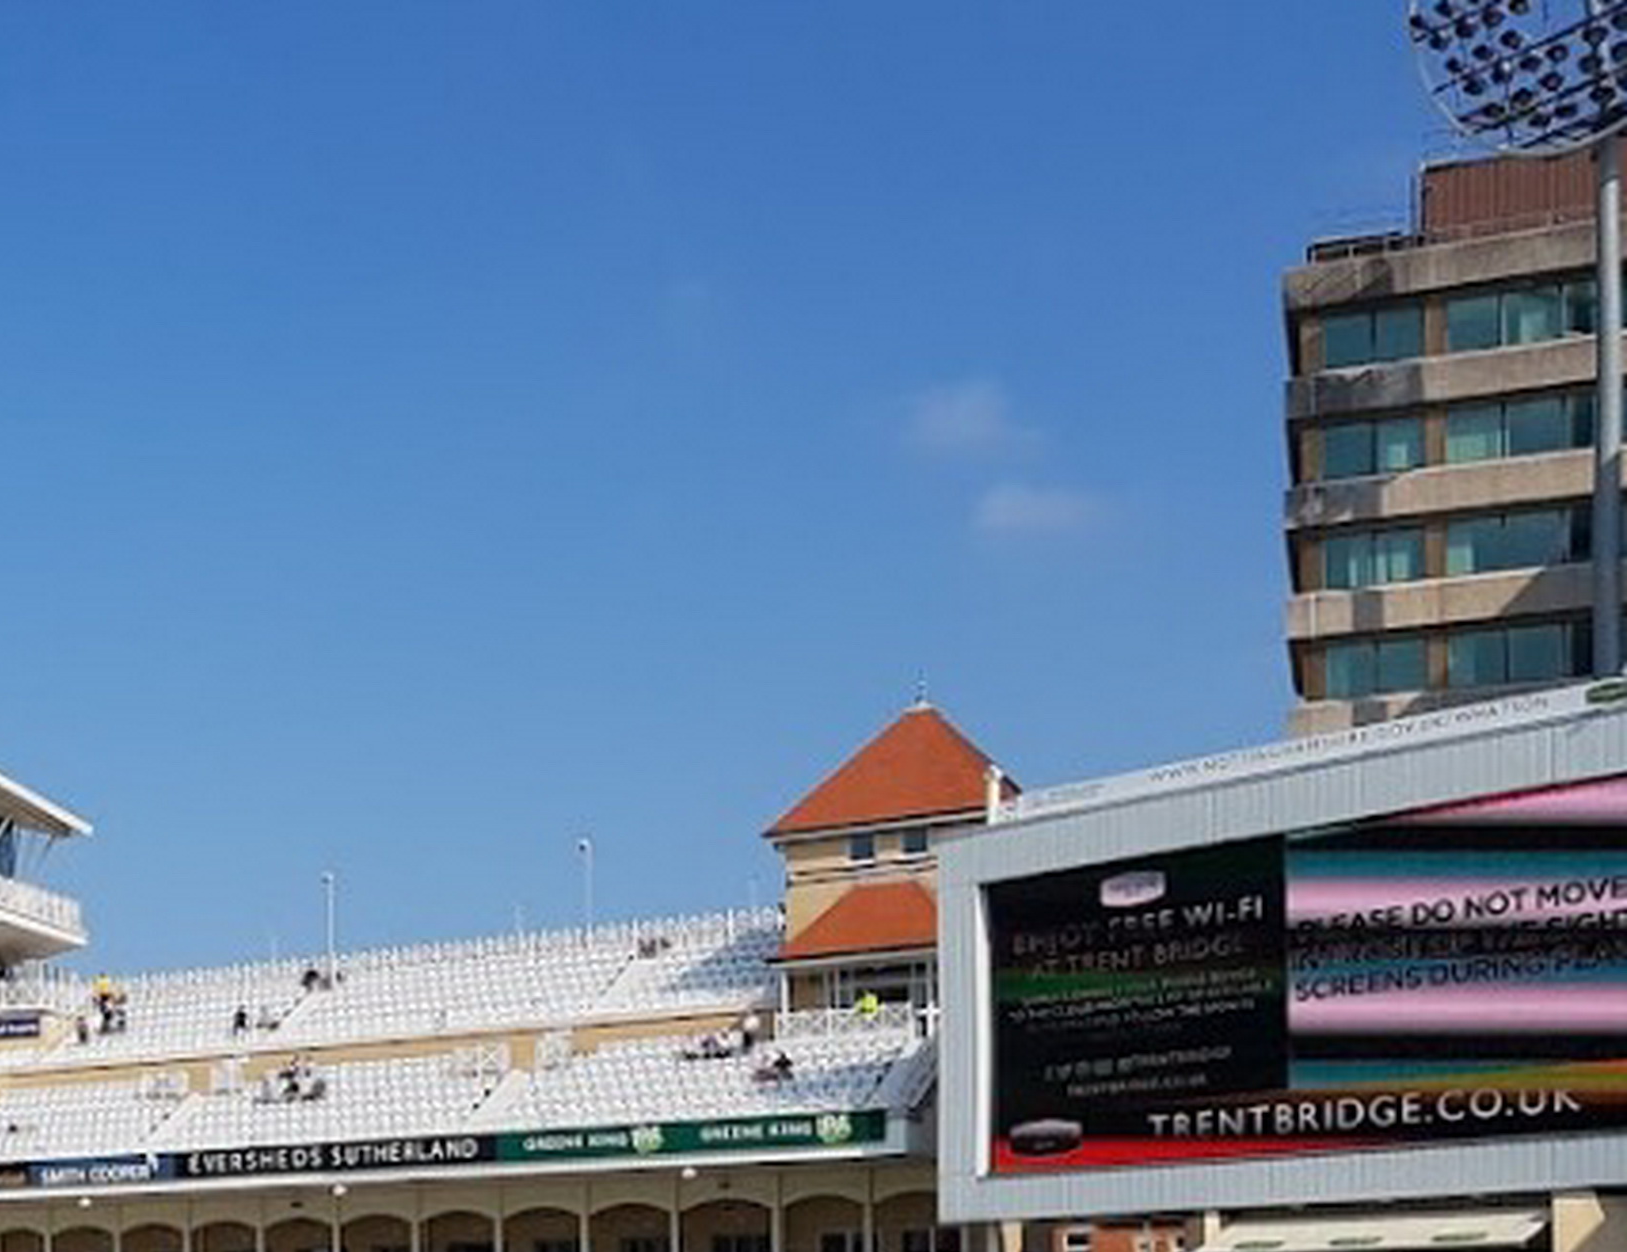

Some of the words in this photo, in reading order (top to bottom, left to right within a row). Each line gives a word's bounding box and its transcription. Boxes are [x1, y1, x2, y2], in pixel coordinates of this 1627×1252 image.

[1180, 894, 1264, 928] WI-FI
[1412, 897, 1454, 927] DO
[1464, 888, 1525, 921] NOT
[1536, 873, 1627, 911] MOVE
[1294, 964, 1424, 1003] SCREENS
[1429, 950, 1546, 987] DURING
[1147, 1088, 1583, 1136] TRENTBRIDGE.CO.UK
[187, 1146, 323, 1175] EVERSHEDS
[329, 1137, 479, 1168] SUTHERLAND
